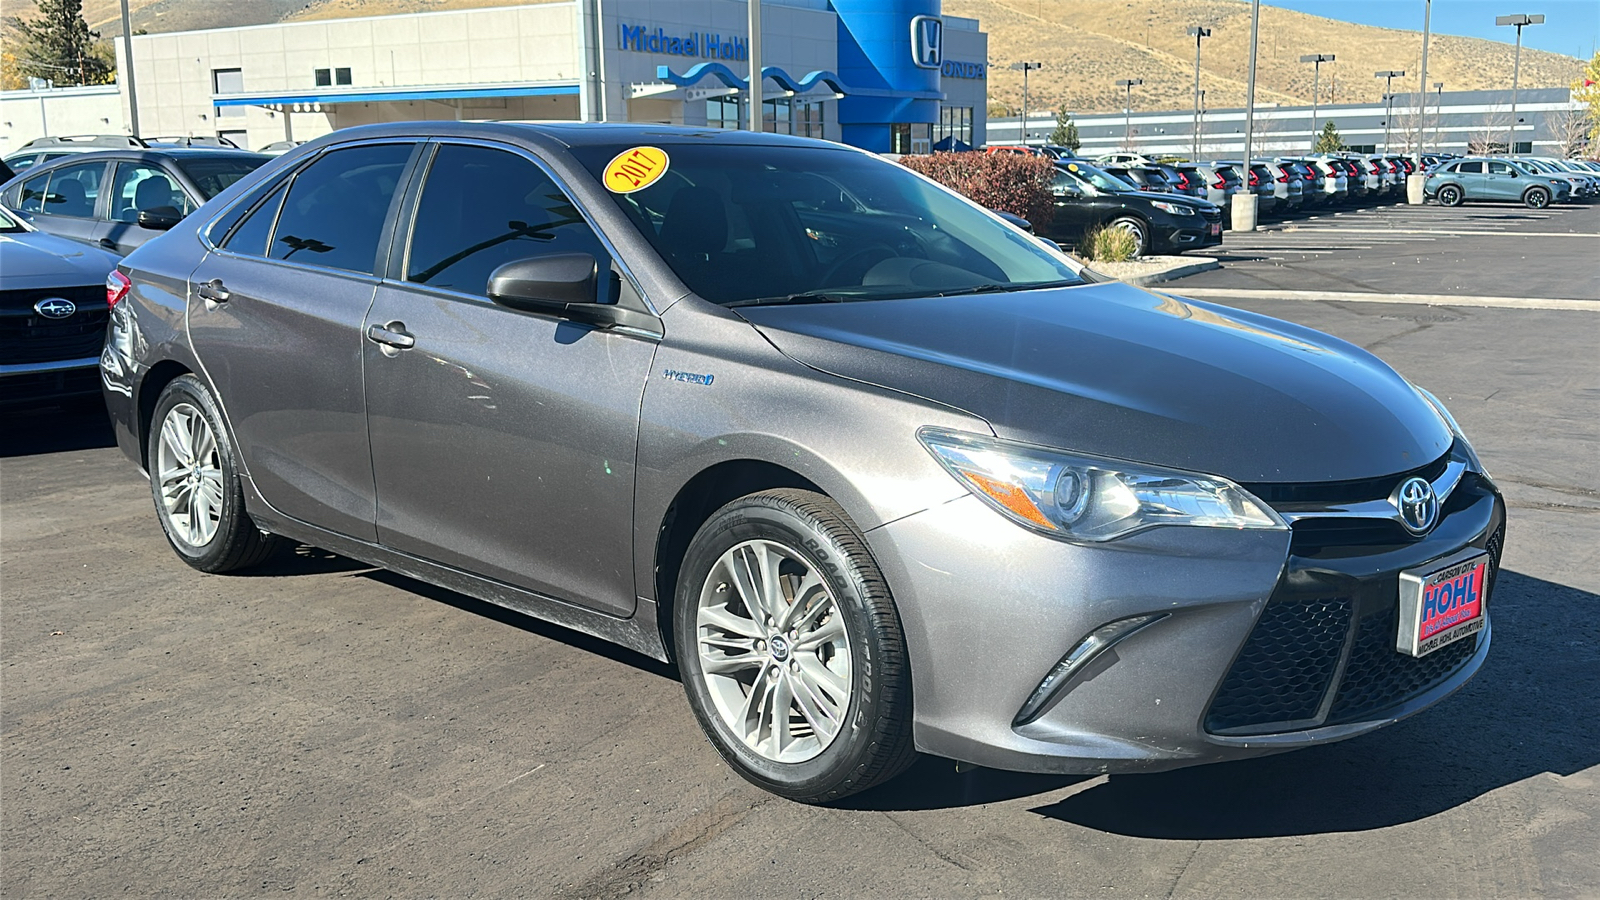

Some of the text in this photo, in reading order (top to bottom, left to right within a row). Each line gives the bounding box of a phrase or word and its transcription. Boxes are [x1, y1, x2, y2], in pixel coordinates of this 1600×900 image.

[620, 24, 699, 57] Michael
[942, 60, 987, 79] ONDA
[614, 150, 657, 187] 2017
[663, 369, 714, 386] HYBRID
[805, 535, 849, 590] ROAD
[1436, 560, 1476, 582] CARSON CITY
[1422, 572, 1478, 623] HOHL
[1418, 619, 1484, 654] MICHAEL HOHL AUTOMOTIVE
